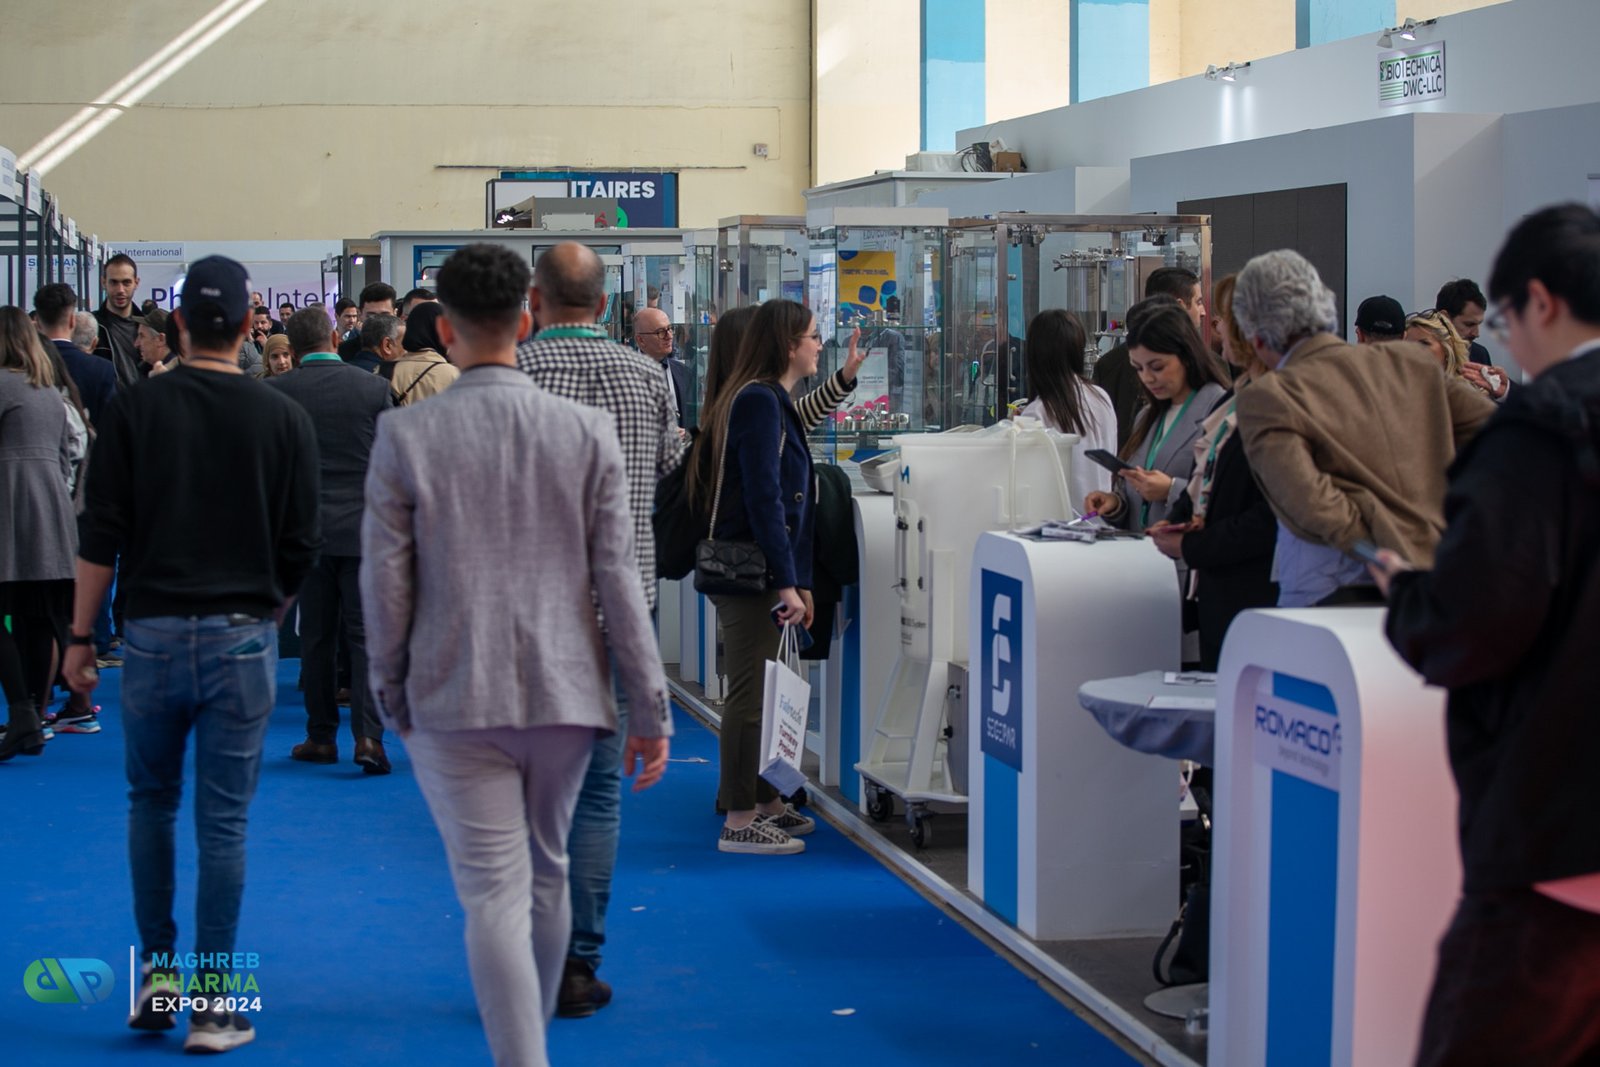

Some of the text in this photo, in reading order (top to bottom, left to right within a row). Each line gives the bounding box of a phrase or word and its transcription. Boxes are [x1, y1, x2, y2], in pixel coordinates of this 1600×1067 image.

[1387, 55, 1442, 81] BIOTECHNICA
[1403, 75, 1442, 97] DWC-LLC
[571, 181, 656, 199] ITAIRES
[125, 247, 182, 257] International
[779, 724, 800, 751] Turnkey
[1255, 705, 1332, 756] ROMACO
